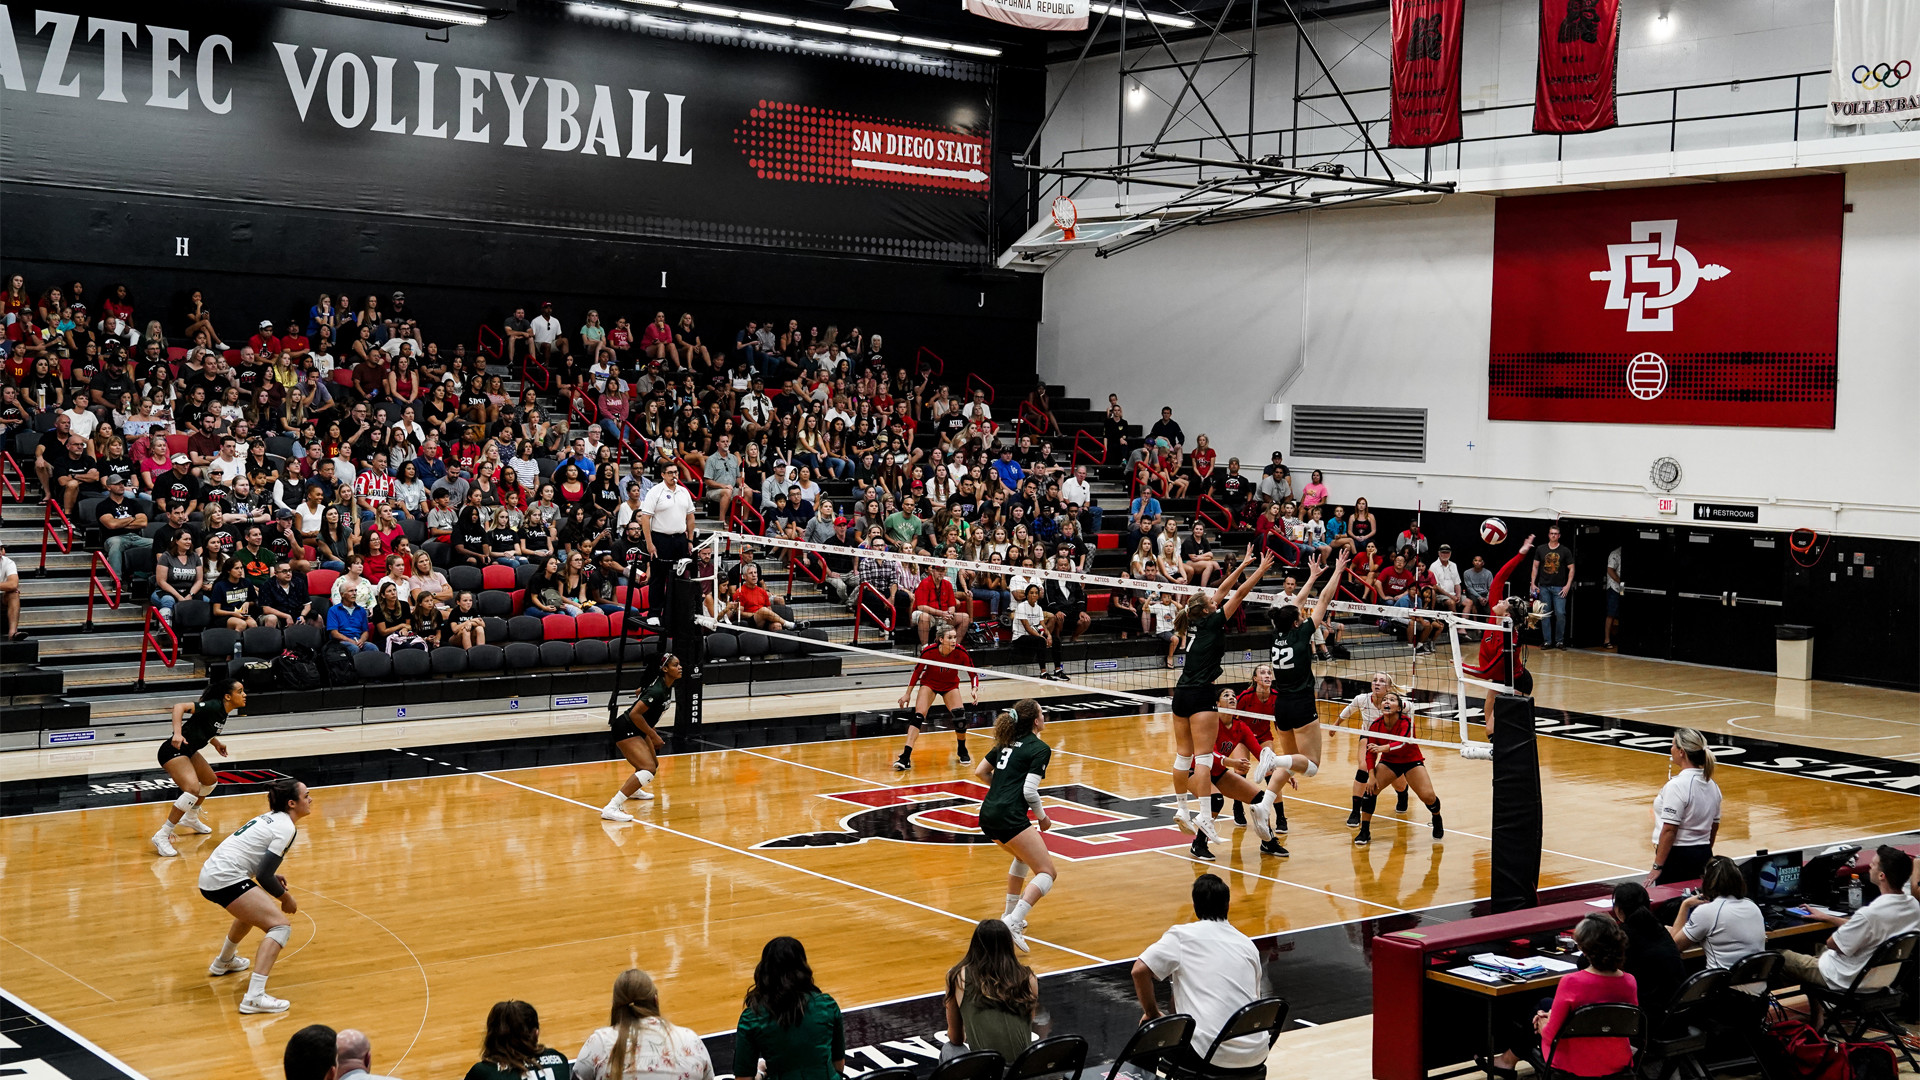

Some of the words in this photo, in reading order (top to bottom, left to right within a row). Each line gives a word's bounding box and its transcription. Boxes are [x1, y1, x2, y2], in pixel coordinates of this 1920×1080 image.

[1037, 1, 1074, 14] REPUBLIC
[272, 42, 694, 165] VOLLEYBALL
[852, 129, 882, 154] SAN
[885, 133, 935, 160] DIEGO
[936, 139, 982, 165] STATE
[175, 237, 189, 257] H
[978, 292, 985, 307] J
[460, 456, 472, 465] 23
[110, 465, 131, 473] Viper
[1659, 500, 1672, 511] EXIT
[1712, 508, 1755, 519] RESTROOMS
[1186, 633, 1196, 652] 7
[1271, 646, 1295, 670] 22
[996, 747, 1013, 770] 3
[1779, 866, 1801, 875] INSTANT
[1780, 873, 1800, 885] REPLAY
